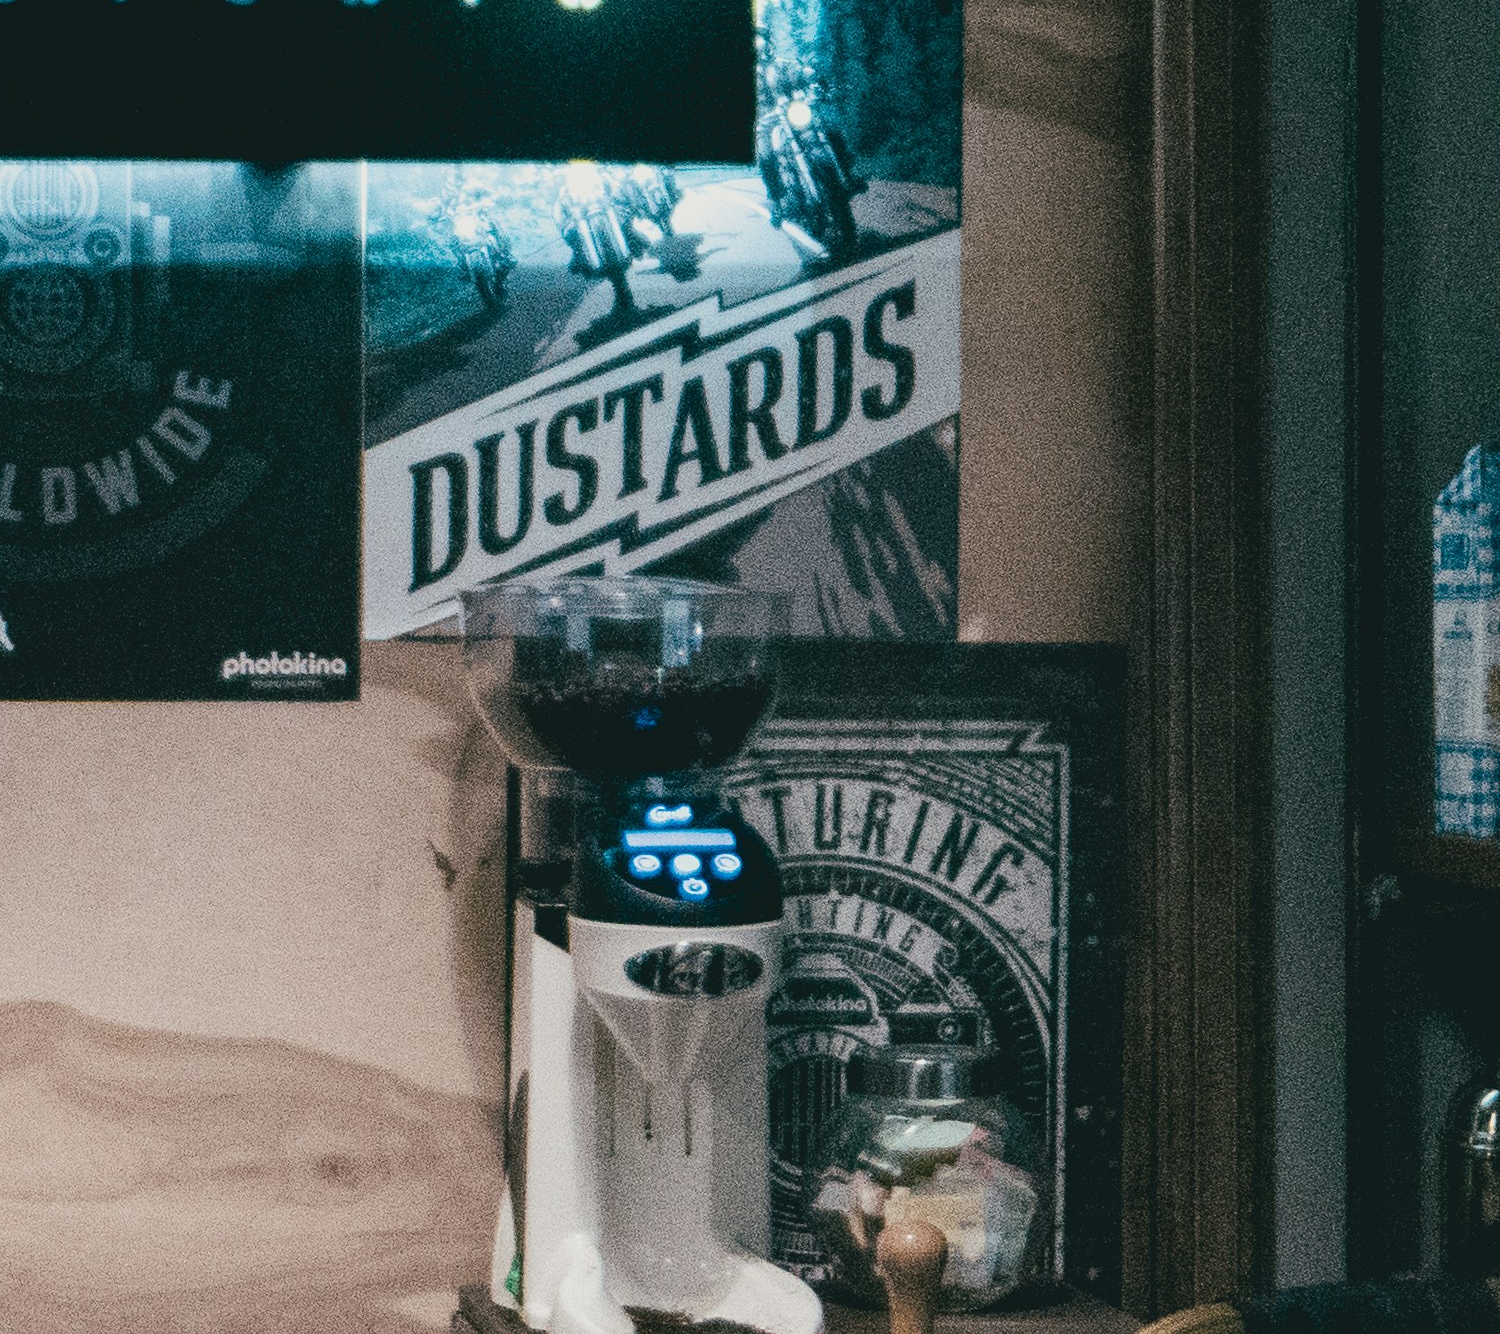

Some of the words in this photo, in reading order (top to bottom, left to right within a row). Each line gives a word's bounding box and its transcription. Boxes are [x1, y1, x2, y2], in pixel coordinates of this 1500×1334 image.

[408, 279, 917, 594] DUSTARDS
[221, 649, 348, 681] photokina
[760, 784, 1025, 906] TURING
[797, 897, 922, 951] HTING
